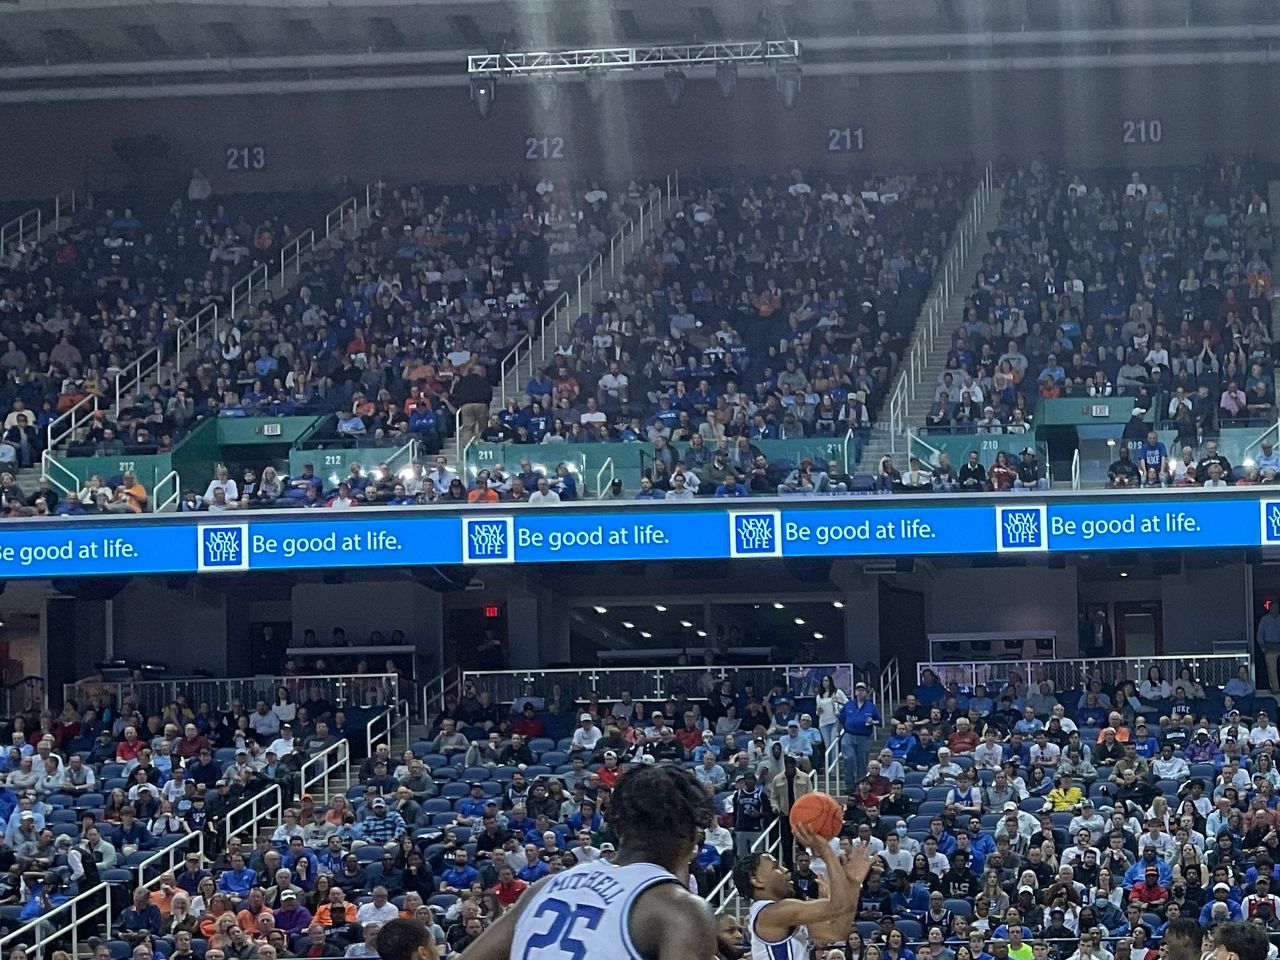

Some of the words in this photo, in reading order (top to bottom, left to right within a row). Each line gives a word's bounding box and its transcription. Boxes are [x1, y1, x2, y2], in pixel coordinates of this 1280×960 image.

[1122, 120, 1162, 143] 210
[828, 128, 864, 150] 211
[525, 137, 565, 160] 212
[226, 147, 265, 170] 213
[983, 440, 999, 451] 210
[325, 455, 342, 466] 212
[478, 450, 494, 460] 211
[119, 461, 135, 471] 212
[1007, 512, 1036, 523] NEW
[741, 518, 770, 529] NEW
[1003, 521, 1039, 533] YORK
[1052, 517, 1077, 535] Be
[1082, 514, 1135, 539] good
[1141, 516, 1161, 533] at
[1167, 512, 1200, 532] life.
[474, 524, 503, 535] NEW
[737, 527, 773, 539] YORK
[787, 523, 811, 541] Be
[817, 520, 870, 545] good
[876, 523, 895, 540] at
[902, 518, 936, 539] life.
[209, 531, 238, 542] NEW
[470, 533, 505, 545] YORK
[519, 529, 543, 547] Be
[549, 526, 602, 551] good
[609, 528, 628, 545] at
[635, 523, 669, 544] life.
[1008, 532, 1035, 543] LIFE
[205, 540, 240, 552] YORK
[254, 536, 278, 553] Be
[283, 533, 336, 558] good
[342, 535, 361, 553] at
[368, 530, 402, 551] life.
[742, 538, 769, 549] LIFE
[20, 541, 73, 565] good
[79, 543, 98, 559] at
[104, 539, 138, 558] life.
[475, 544, 502, 555] LIFE
[210, 551, 237, 562] LIFE
[1172, 705, 1191, 714] DUKE
